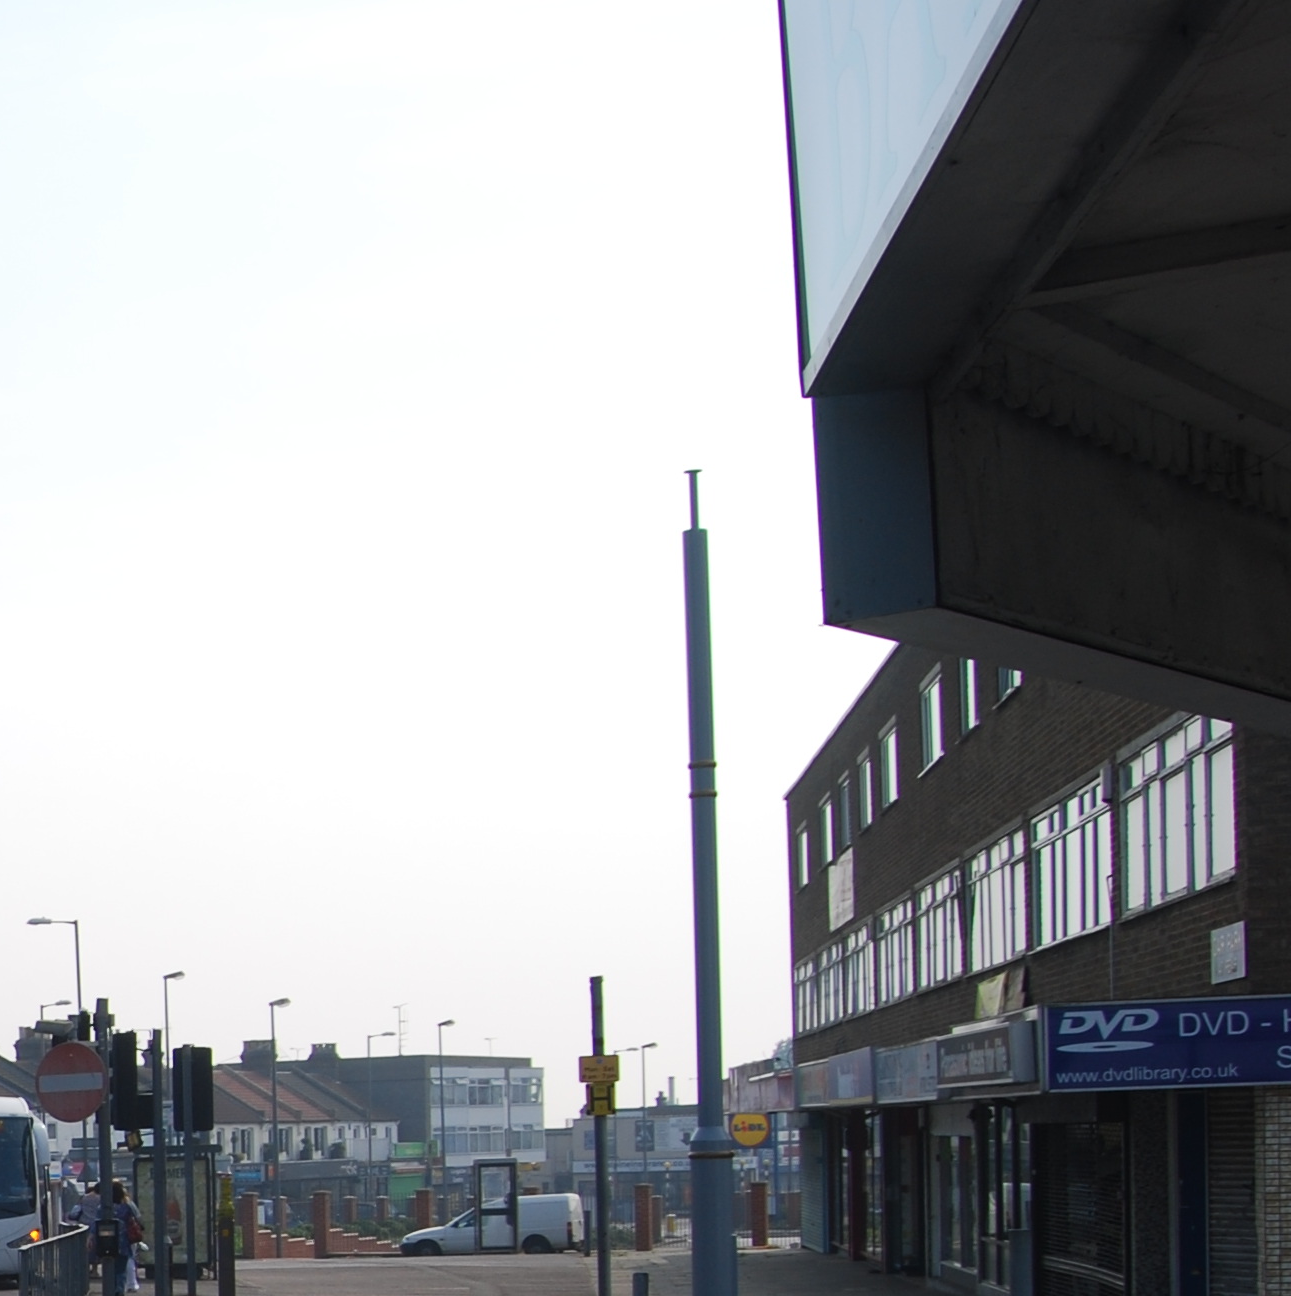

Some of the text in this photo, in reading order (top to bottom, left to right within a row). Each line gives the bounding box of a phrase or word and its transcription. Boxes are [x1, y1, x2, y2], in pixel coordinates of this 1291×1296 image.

[1058, 1008, 1160, 1040] DVD
[1178, 1010, 1250, 1037] DVD
[1056, 1063, 1239, 1084] www.dvdlibrary.co.uk
